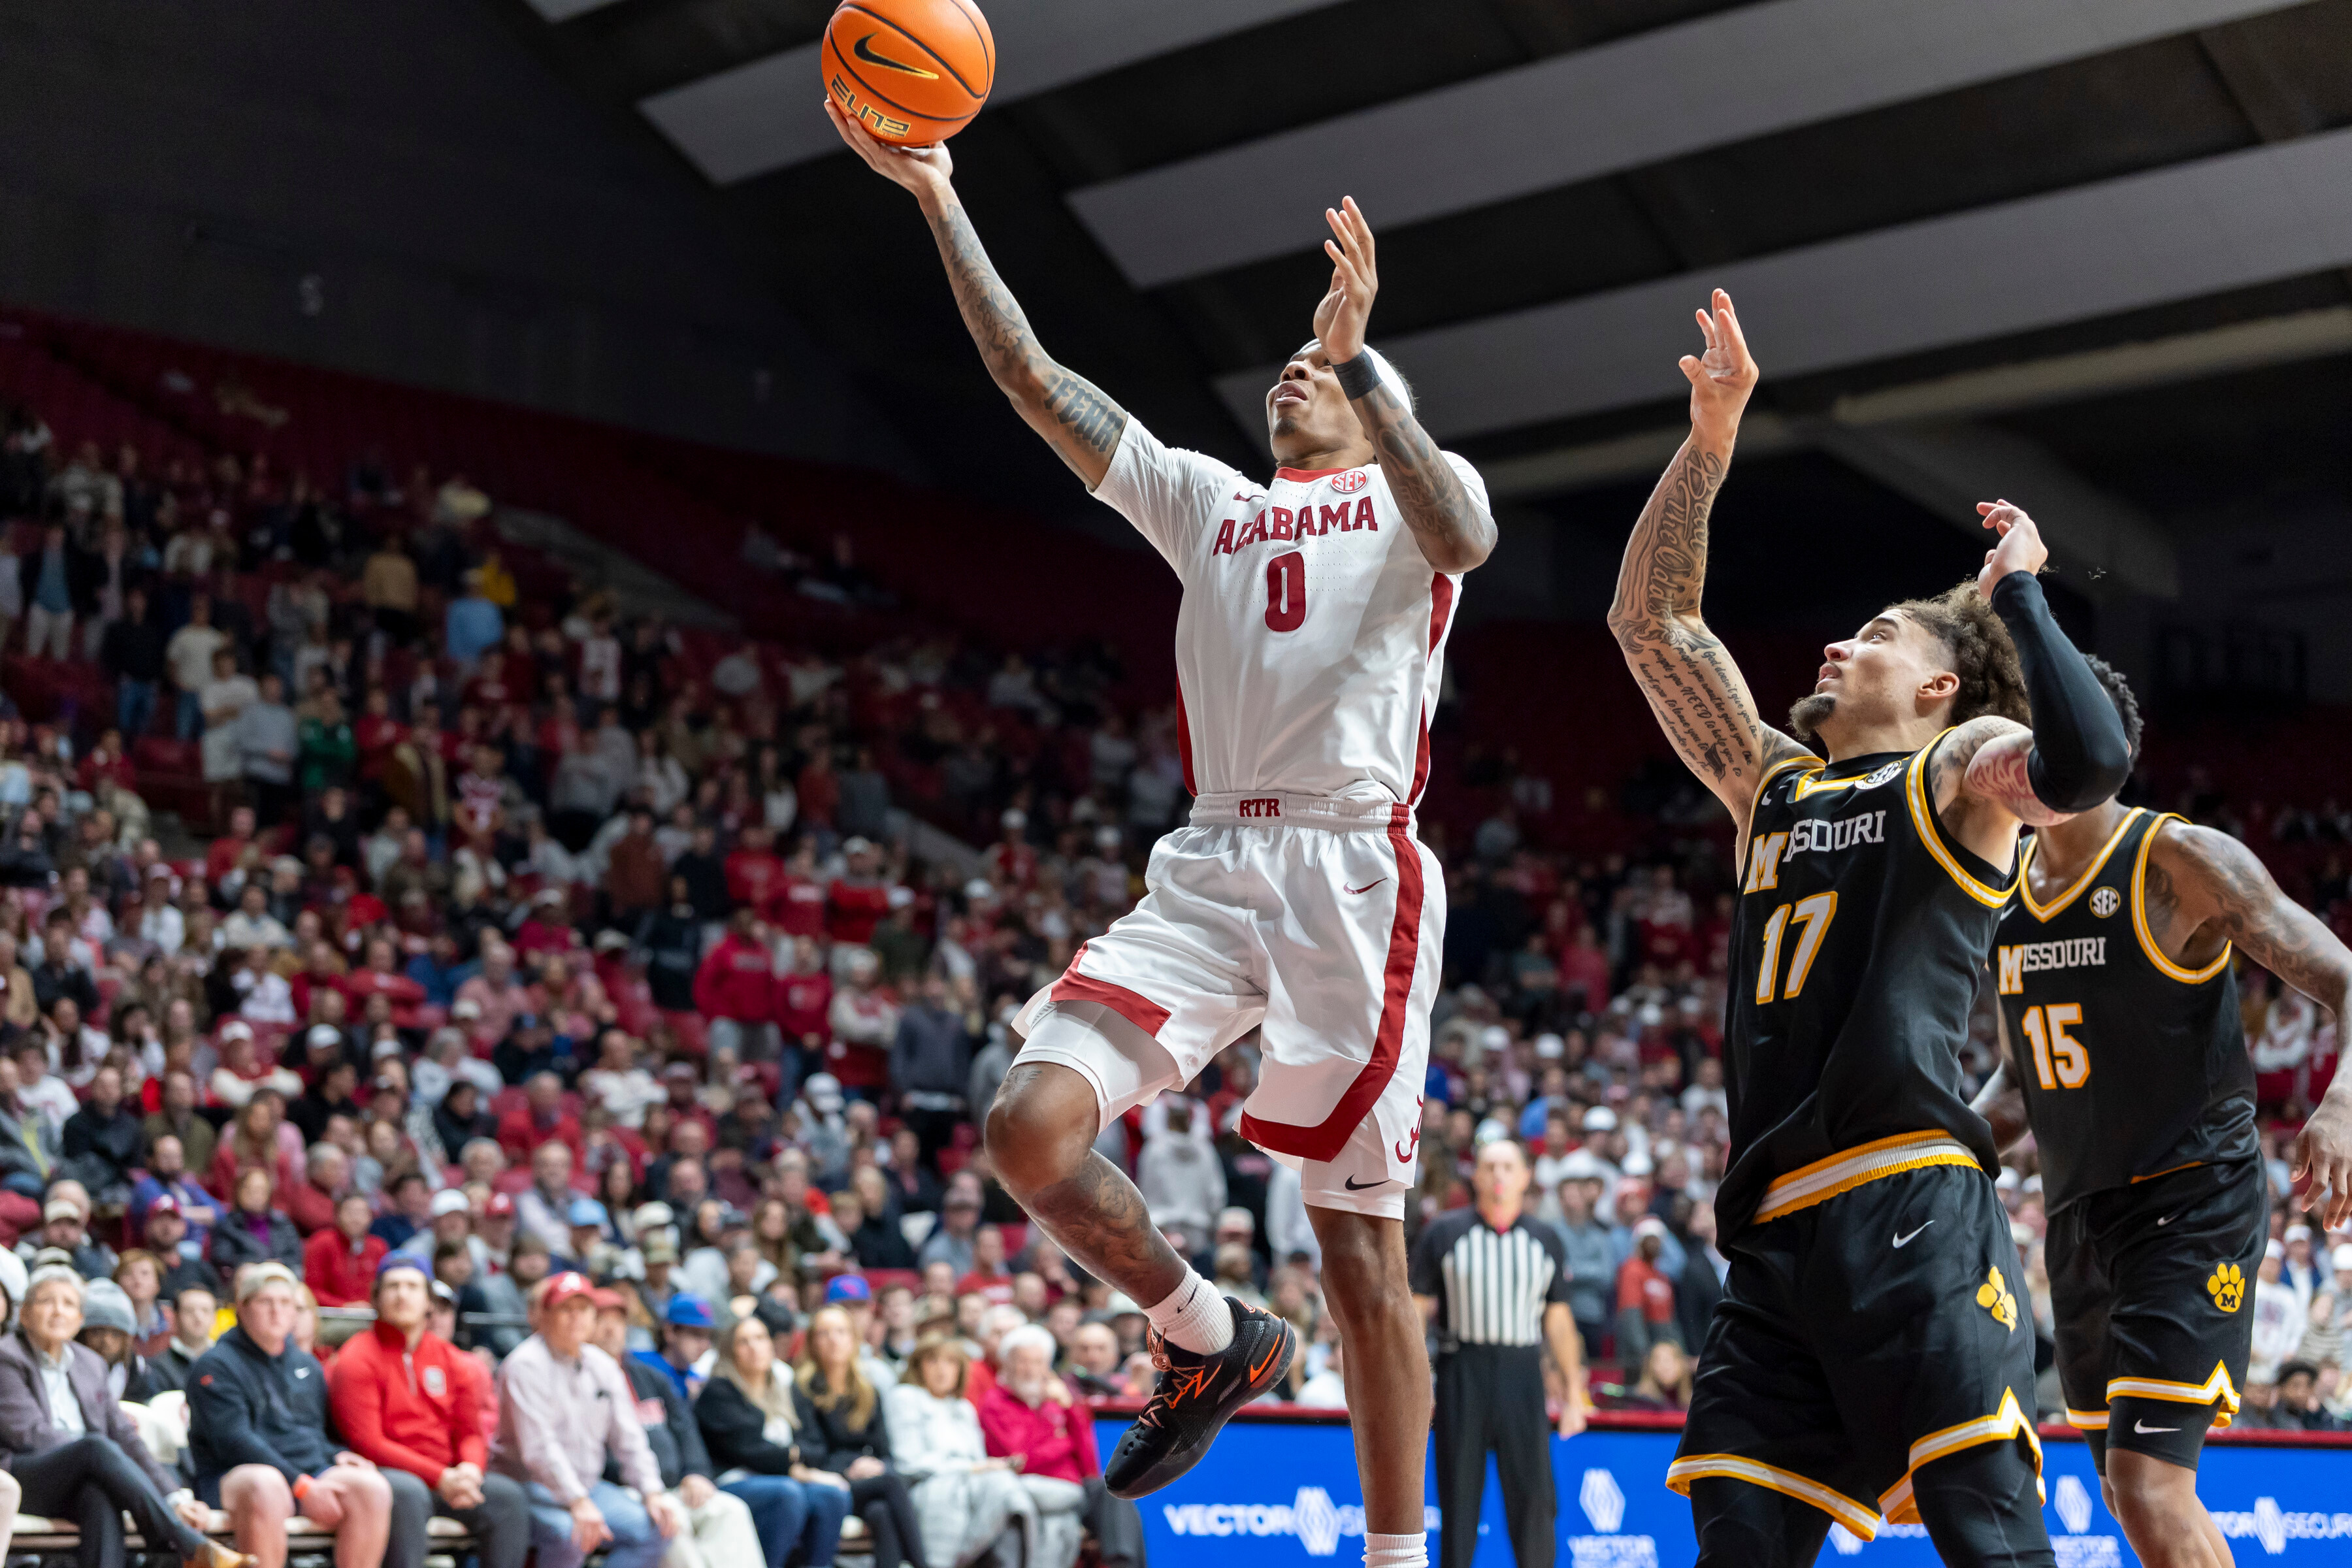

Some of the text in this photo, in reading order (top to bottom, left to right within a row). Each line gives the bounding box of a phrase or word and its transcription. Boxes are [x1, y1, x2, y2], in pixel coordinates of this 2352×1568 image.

[831, 73, 911, 137] ELITE
[1333, 471, 1366, 491] SEC
[1213, 496, 1378, 557] ALABAMA
[1265, 551, 1306, 632] 0
[1687, 668, 1705, 683] you
[1701, 652, 1722, 666] God
[1737, 710, 1751, 724] you
[1680, 687, 1712, 719] NEED
[1867, 762, 1899, 783] SEC
[1239, 798, 1281, 817] RTR
[1744, 810, 1886, 894] MISOURI
[2092, 889, 2117, 915] SEC
[1756, 890, 1838, 1005] 17
[1998, 937, 2106, 995] MISSOURI
[2021, 1002, 2091, 1090] 15
[2221, 1293, 2236, 1308] M
[1162, 1503, 1295, 1536] VECTOR
